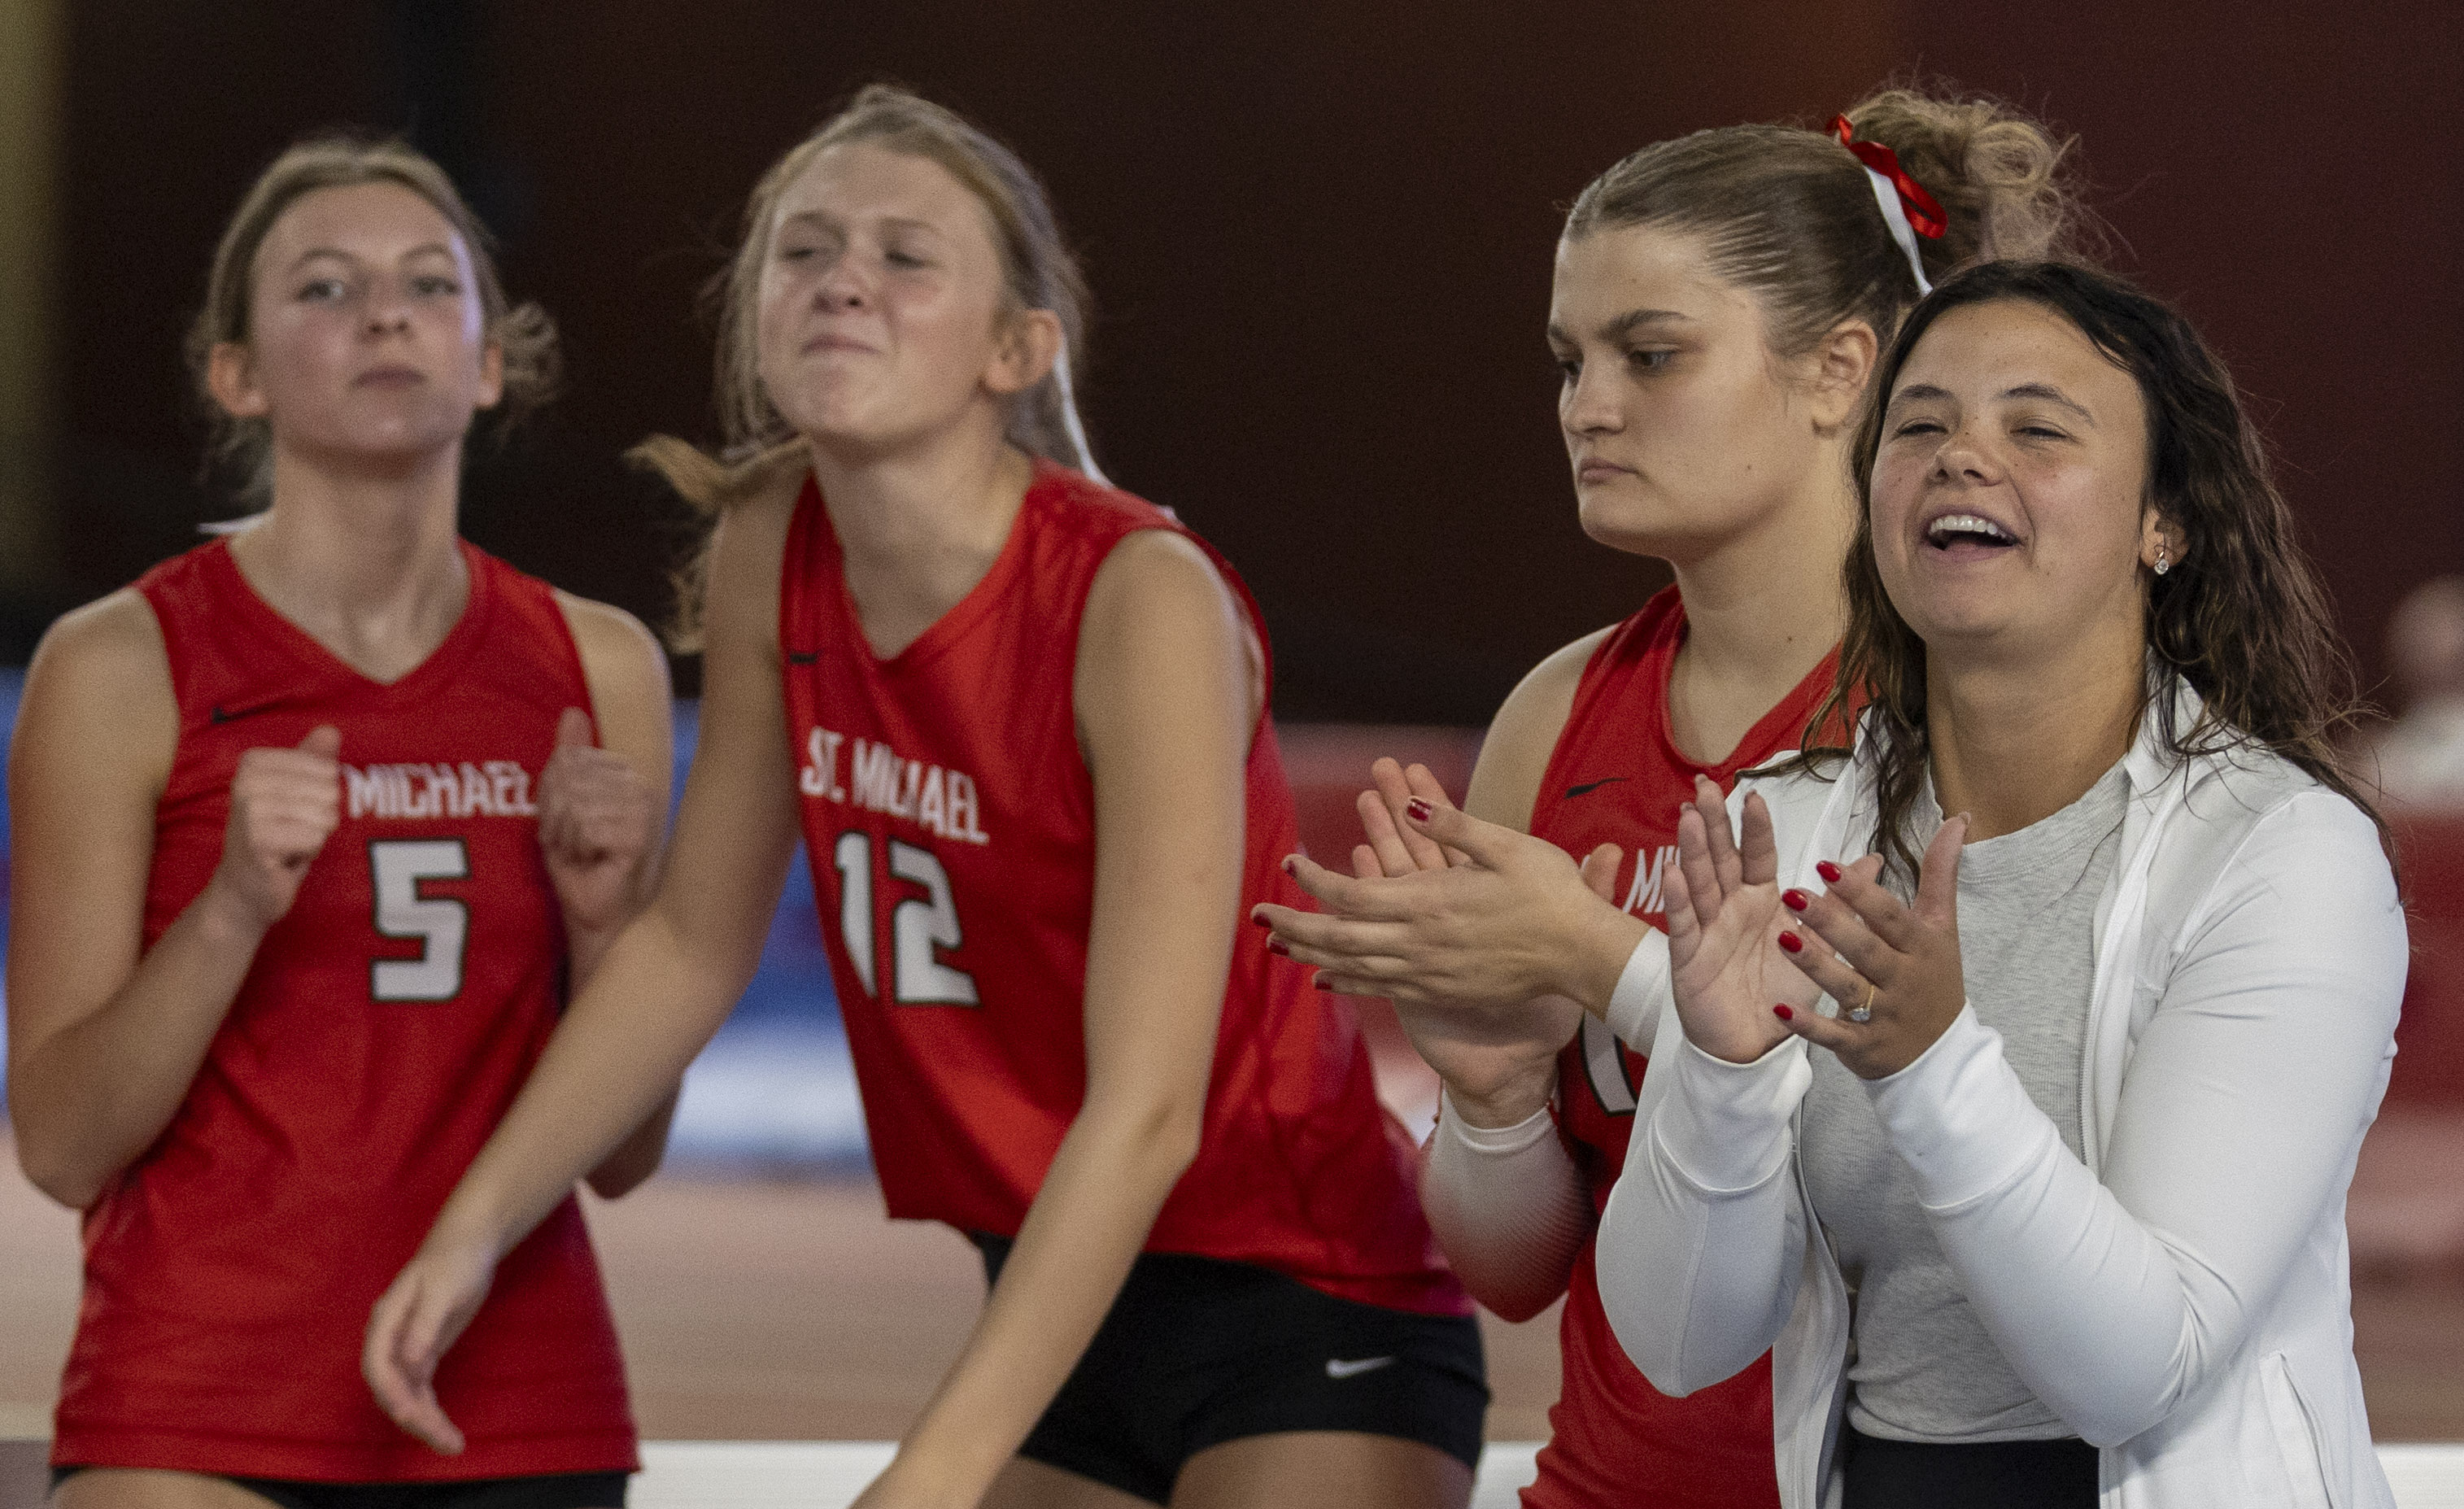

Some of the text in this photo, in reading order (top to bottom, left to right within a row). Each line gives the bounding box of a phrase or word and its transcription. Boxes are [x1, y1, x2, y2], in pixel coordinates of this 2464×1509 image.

[342, 761, 539, 818] MICHAEL
[800, 726, 846, 804] ST.
[369, 837, 472, 1005] 5
[835, 828, 982, 1007] 12
